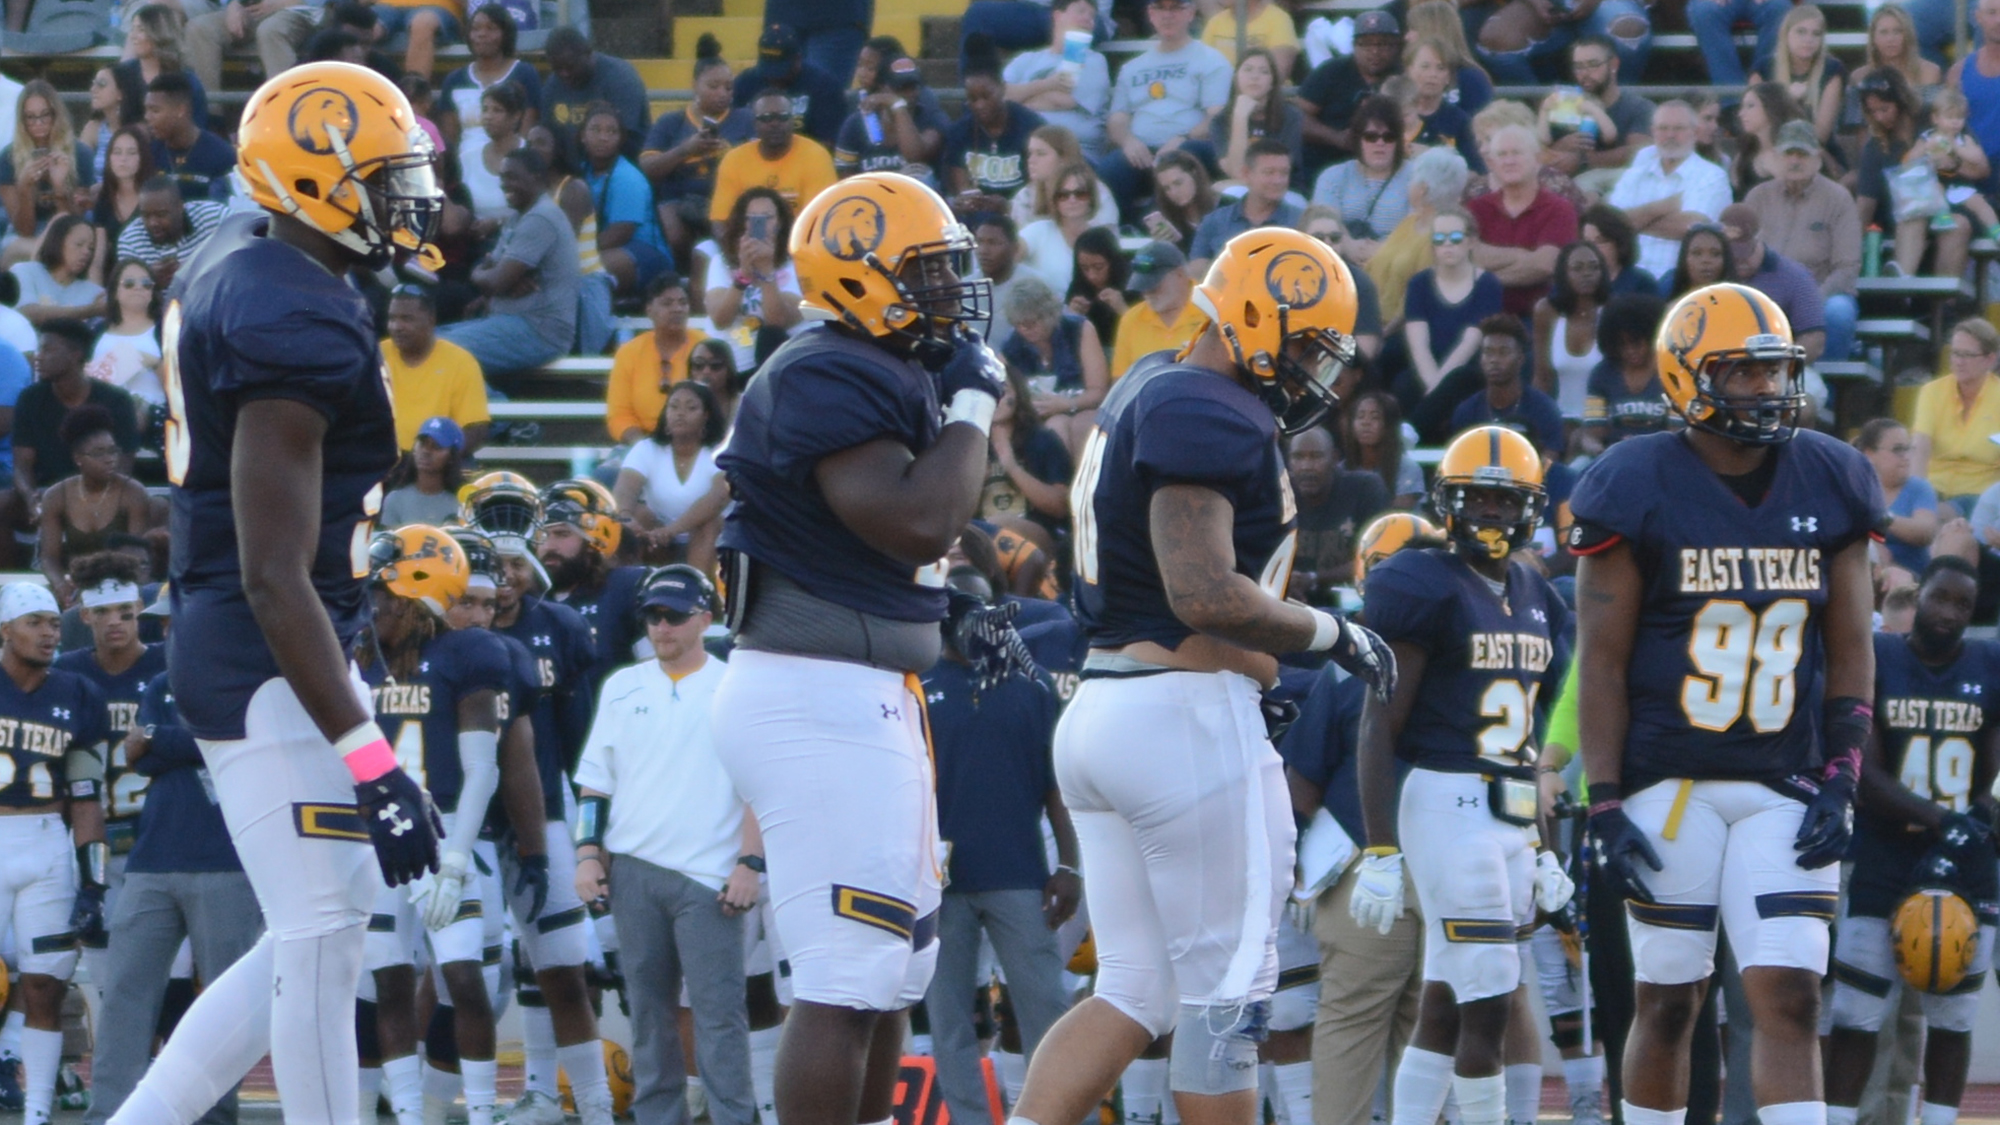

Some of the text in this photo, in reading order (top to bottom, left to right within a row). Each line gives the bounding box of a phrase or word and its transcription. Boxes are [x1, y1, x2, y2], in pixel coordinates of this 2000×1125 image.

[1680, 548, 1821, 592] EAST TEXAS
[1471, 633, 1514, 669] EAST
[1680, 599, 1809, 733] 98
[381, 686, 431, 714] TEXAS
[1887, 699, 1984, 732] EAST TEXAS
[1900, 734, 1976, 815] 49
